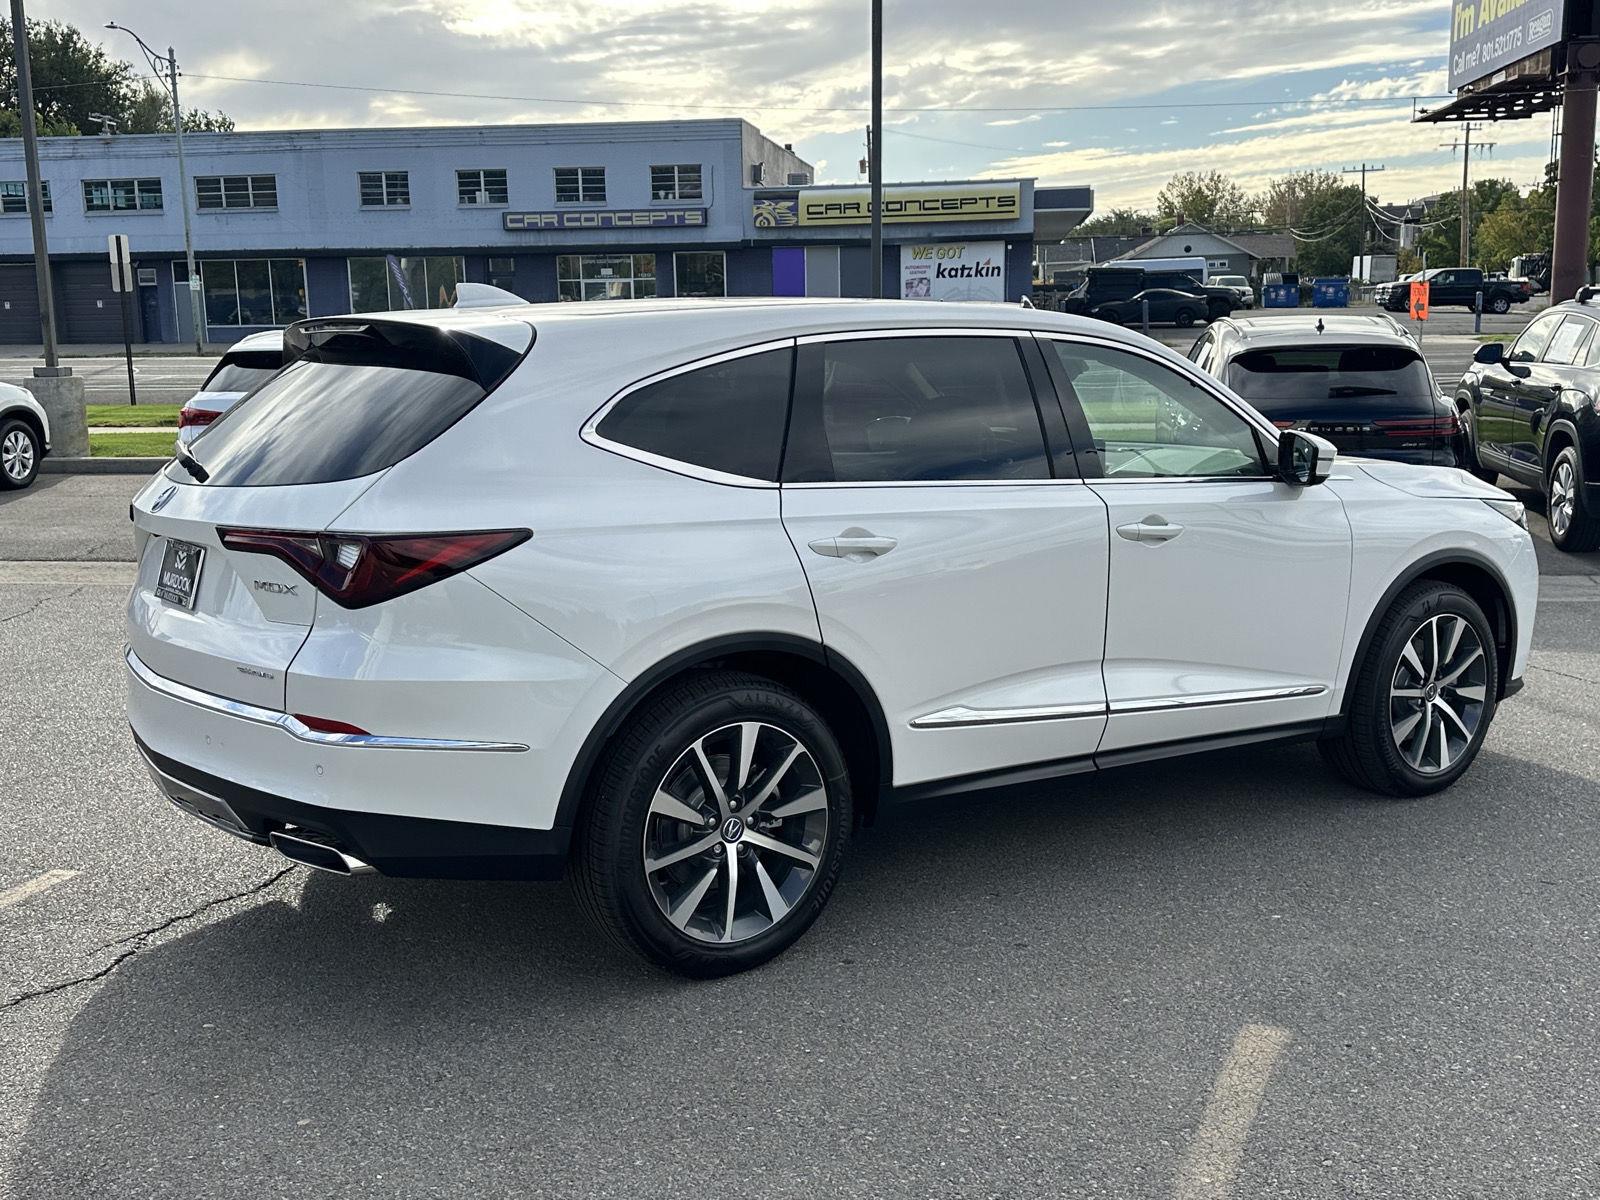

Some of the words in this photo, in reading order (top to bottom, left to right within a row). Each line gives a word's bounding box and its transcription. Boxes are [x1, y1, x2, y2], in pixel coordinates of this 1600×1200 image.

[1454, 3, 1474, 42] I'm
[1453, 51, 1465, 76] Call
[1466, 42, 1480, 70] me?
[807, 203, 860, 215] CAR
[507, 214, 558, 227] CAR
[564, 211, 703, 227] CONCEPTS
[911, 247, 934, 260] WE
[936, 246, 966, 260] GOT
[936, 258, 1001, 279] katzkin
[162, 571, 191, 593] MURDOCK
[253, 580, 299, 596] MDX
